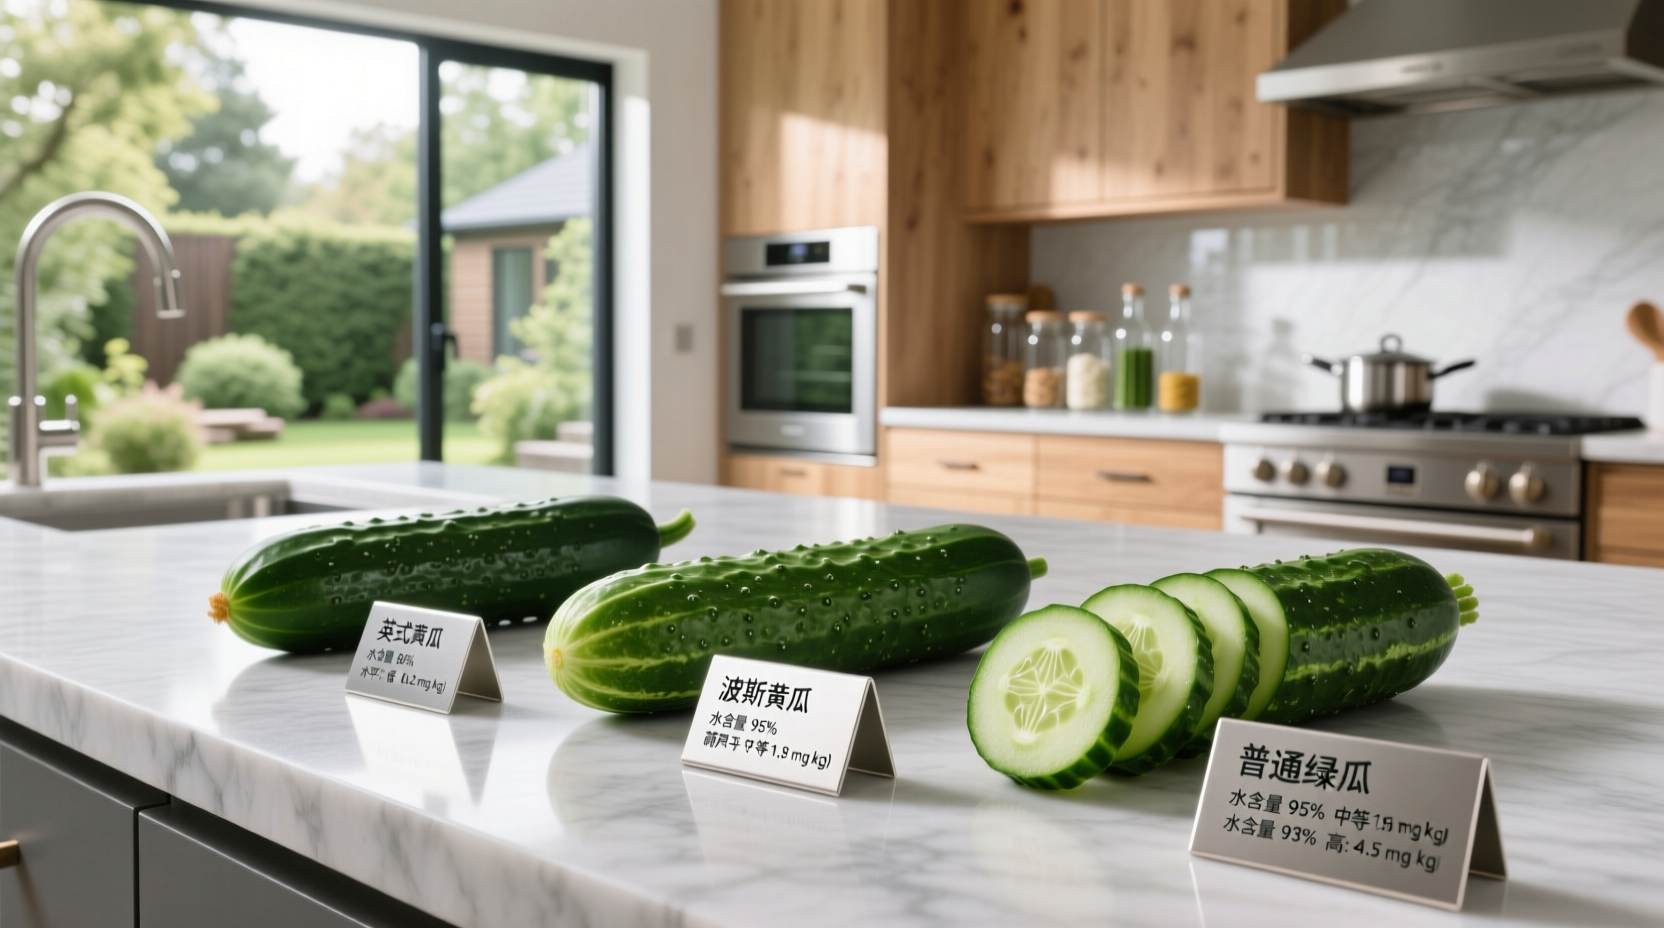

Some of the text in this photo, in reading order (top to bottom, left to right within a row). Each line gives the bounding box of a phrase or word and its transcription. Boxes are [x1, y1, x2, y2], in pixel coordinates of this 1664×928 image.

[377, 617, 443, 649] 英式黄瓜
[718, 675, 812, 713] 波斯黄瓜
[709, 711, 777, 735] 水含量 95%
[791, 751, 809, 767] mg
[811, 751, 832, 770] kg)
[1240, 743, 1372, 794] 普通绿瓜
[1229, 788, 1282, 814] 水含量
[1288, 799, 1325, 820] 95%
[1334, 806, 1370, 831] 中等
[1398, 821, 1422, 841] mg
[1223, 813, 1275, 839] 水含量
[1281, 825, 1317, 846] 93%
[1353, 839, 1382, 858] 4.5
[1385, 848, 1411, 868] mg
